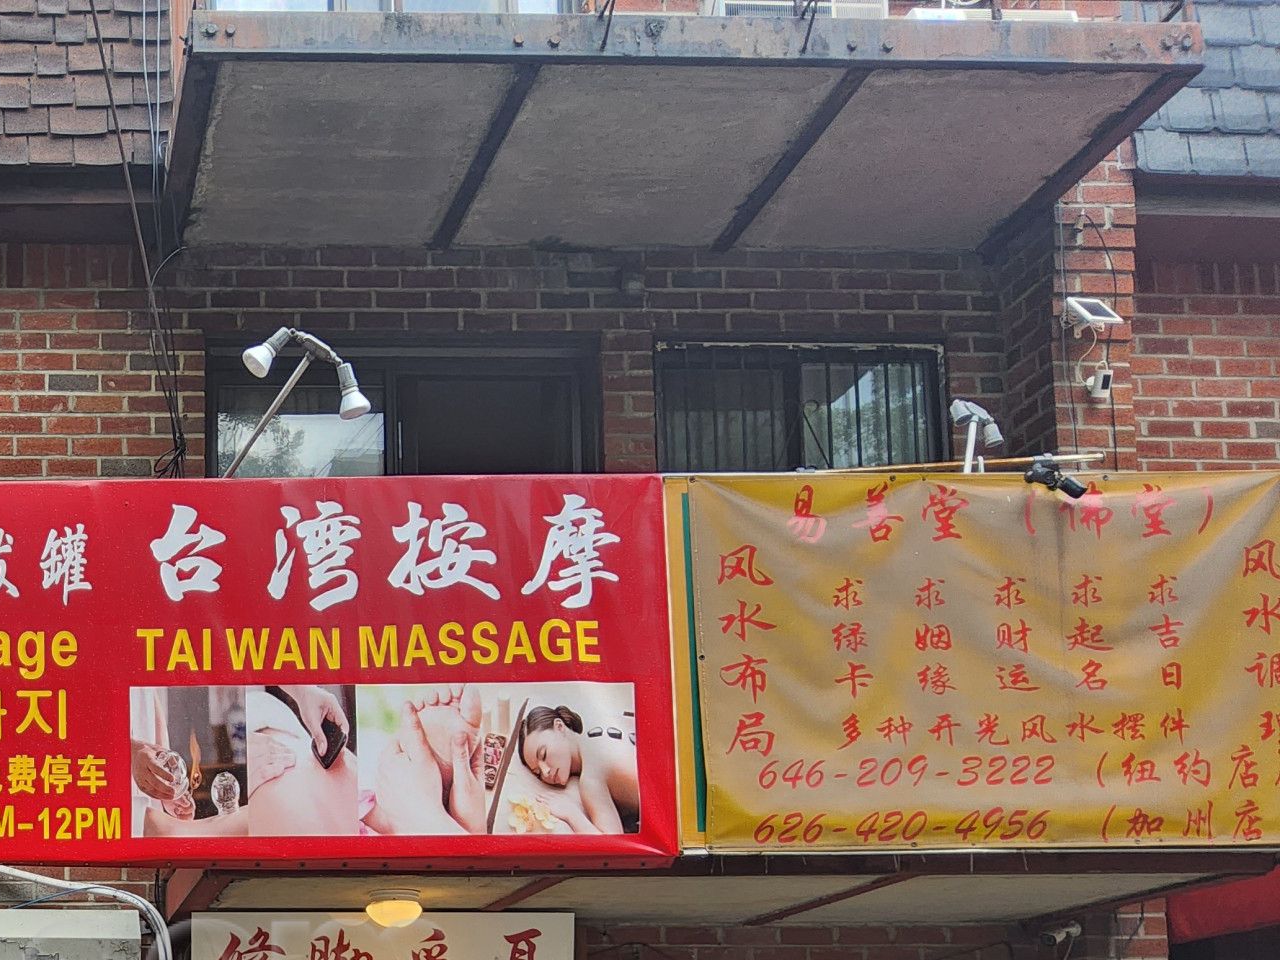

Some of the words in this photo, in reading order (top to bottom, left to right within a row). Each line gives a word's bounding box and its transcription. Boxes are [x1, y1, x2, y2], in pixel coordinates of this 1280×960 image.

[149, 493, 621, 612] 台湾按摩
[136, 628, 212, 672] TAI
[225, 626, 341, 671] WAN
[358, 618, 602, 670] MASSAGE
[757, 753, 1056, 791] 646-209-3222
[752, 805, 1052, 846] 626-420-4956
